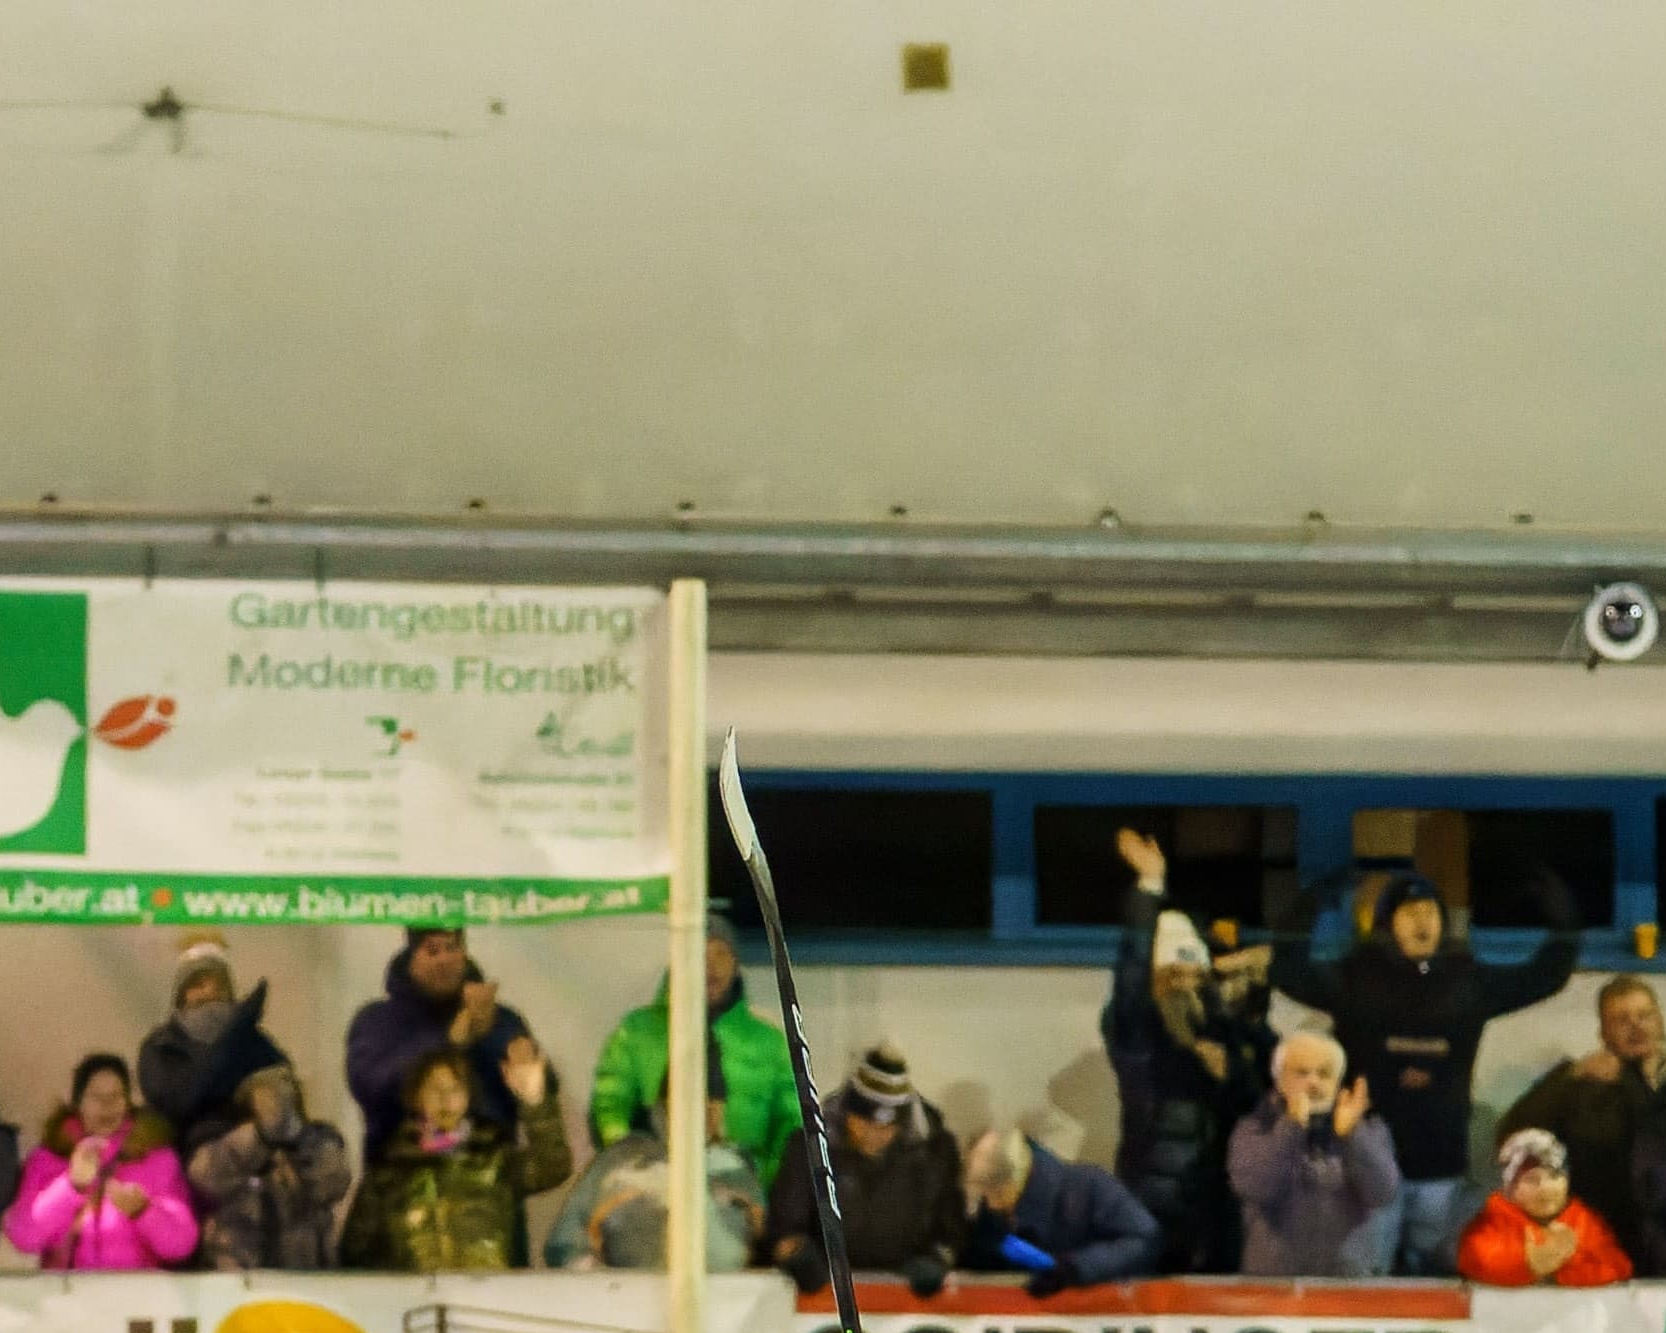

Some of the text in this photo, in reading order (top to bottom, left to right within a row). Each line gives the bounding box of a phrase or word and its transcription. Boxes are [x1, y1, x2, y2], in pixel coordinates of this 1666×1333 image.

[230, 593, 637, 644] Gartengestaltung
[226, 653, 636, 695] Moderne Floristik
[183, 886, 639, 920] www.blumen-tauber.at
